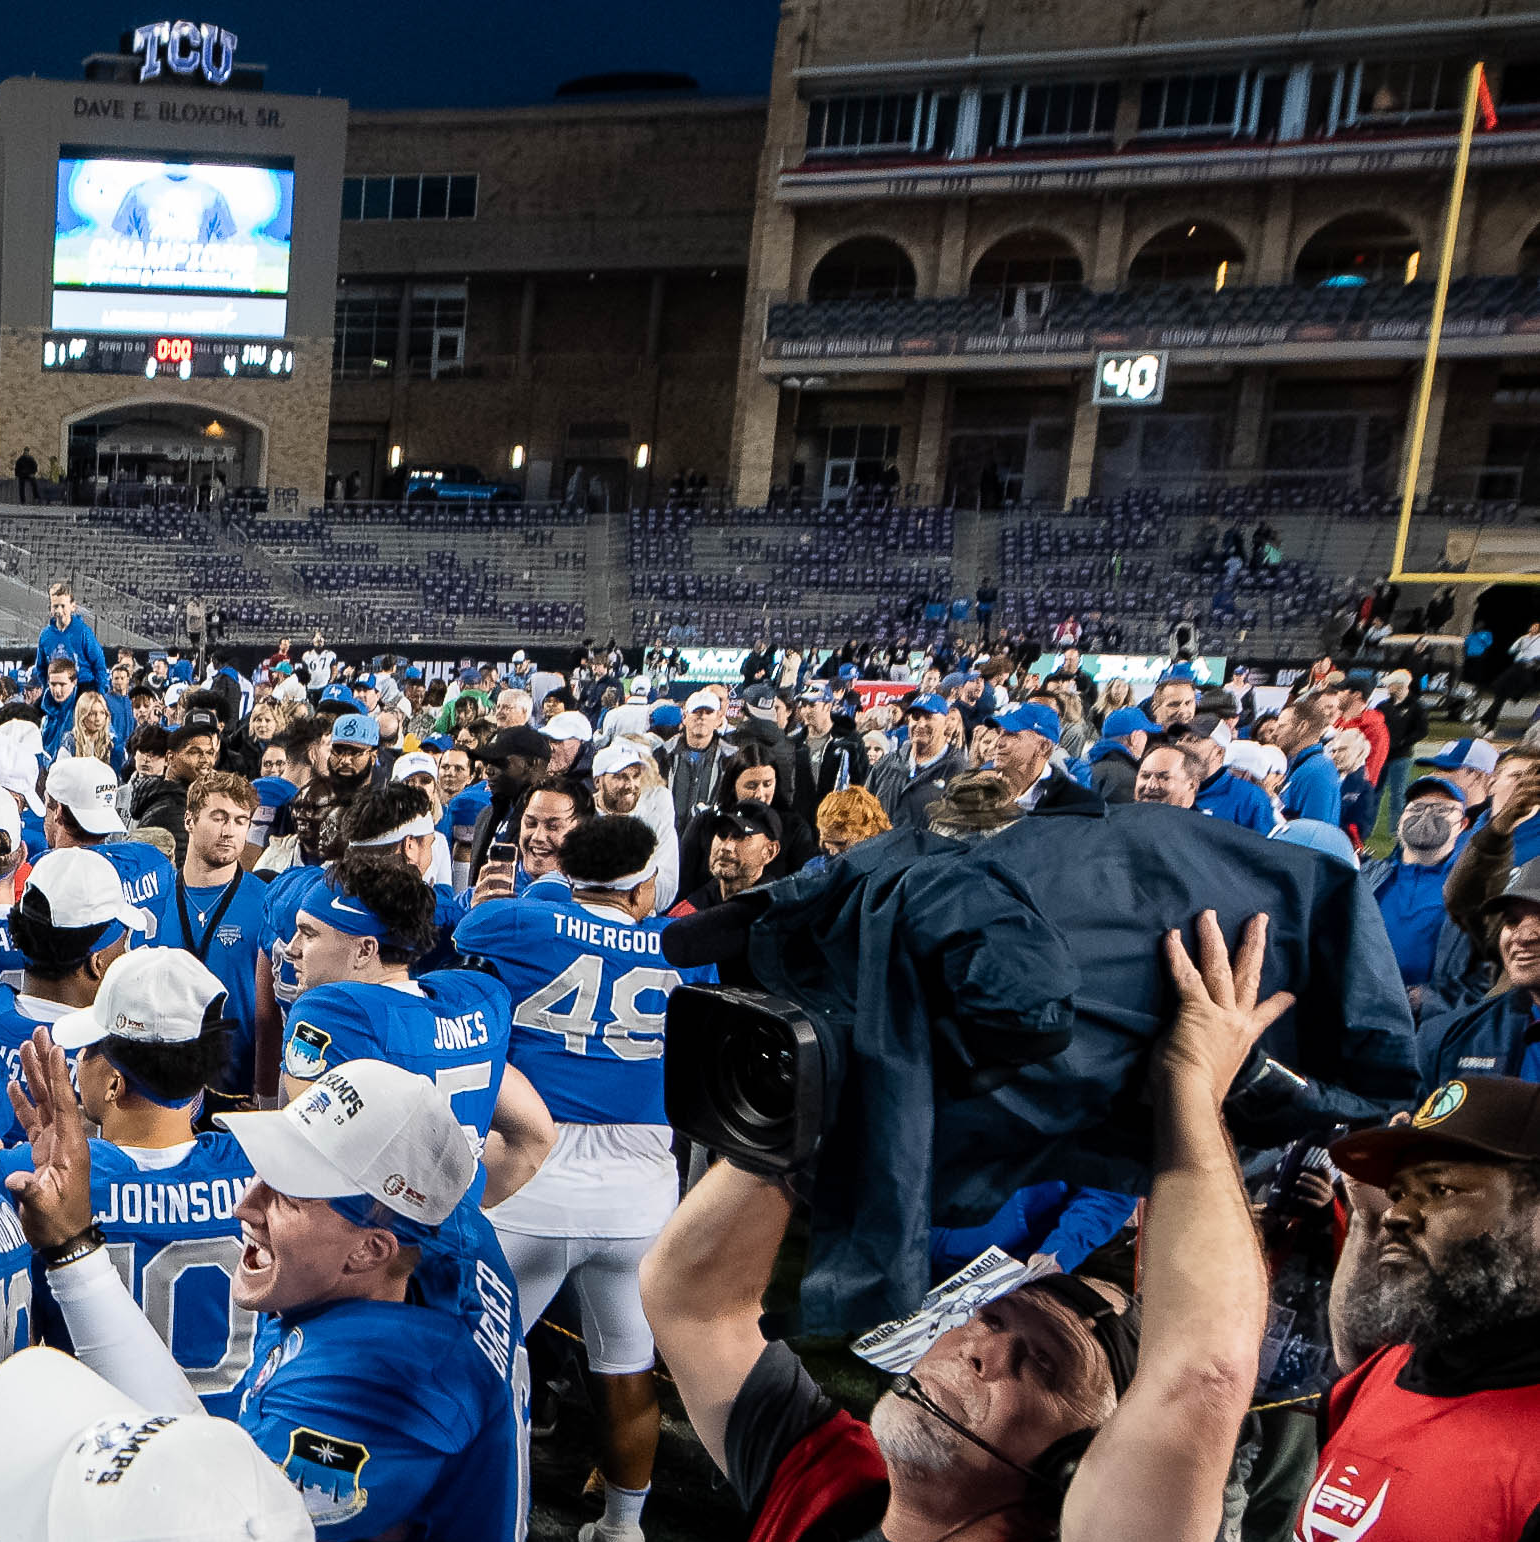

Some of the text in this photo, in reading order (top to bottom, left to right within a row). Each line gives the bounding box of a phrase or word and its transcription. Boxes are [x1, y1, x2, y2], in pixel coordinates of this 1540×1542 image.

[133, 19, 239, 86] TCU
[73, 97, 125, 120] DAVE
[156, 338, 193, 361] 0:00
[1102, 354, 1159, 400] 40
[553, 913, 664, 958] THIERGOO
[434, 1010, 489, 1051] JONES
[98, 1178, 254, 1226] JOHNSON
[473, 1260, 515, 1382] BRIER
